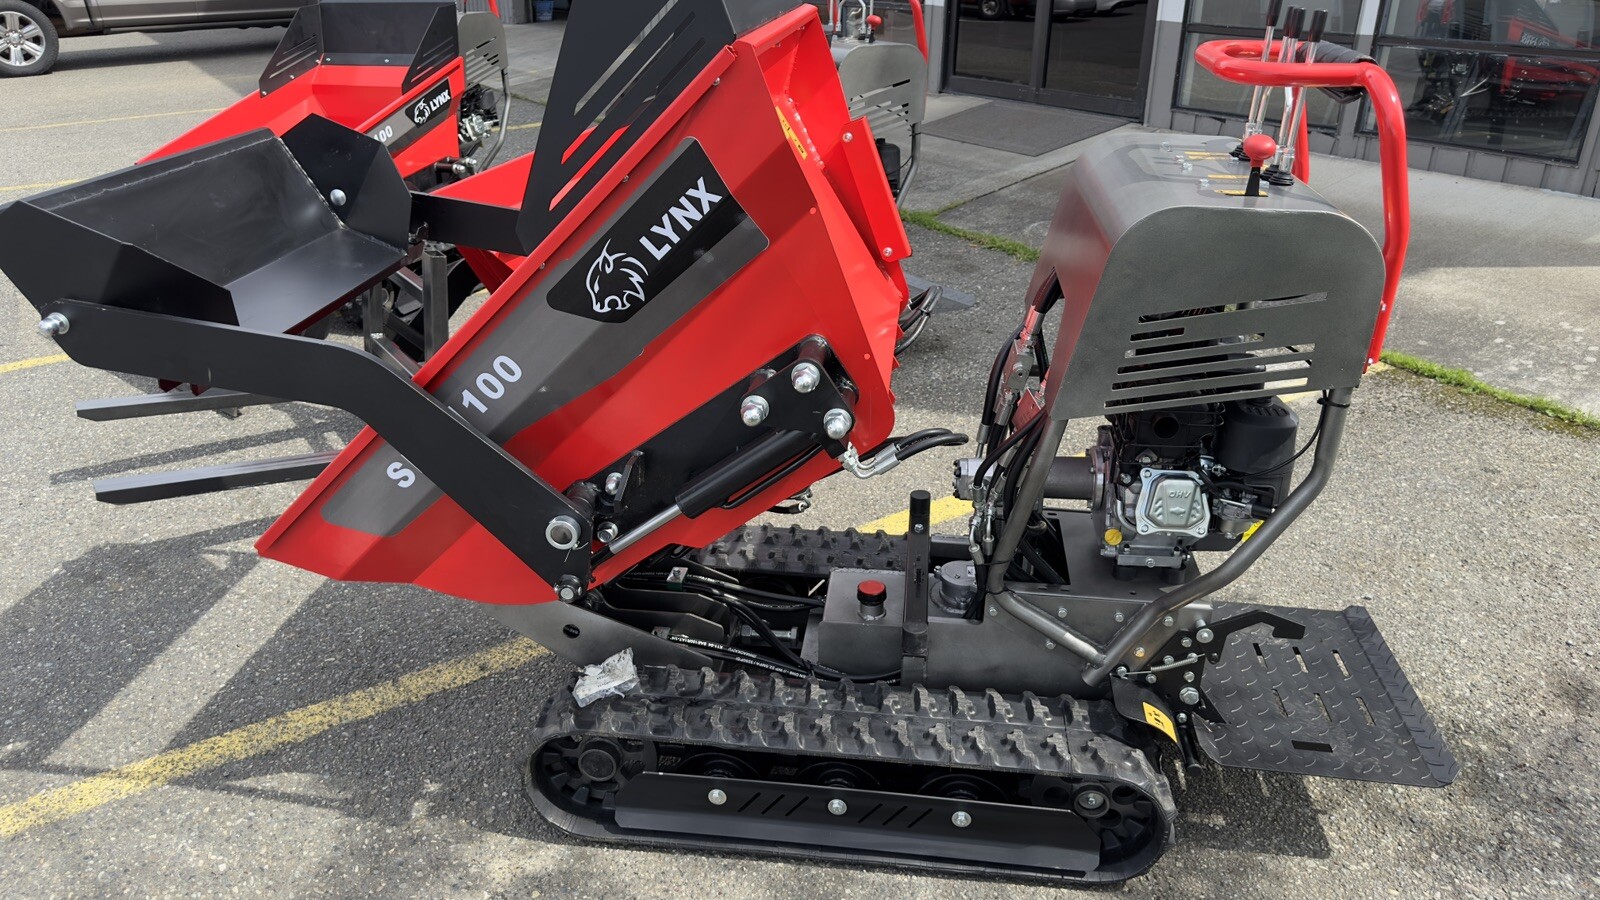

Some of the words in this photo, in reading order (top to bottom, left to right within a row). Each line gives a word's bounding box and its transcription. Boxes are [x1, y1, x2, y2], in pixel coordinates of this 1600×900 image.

[429, 89, 451, 112] LYNX
[639, 176, 723, 261] LYNX
[461, 355, 522, 414] 100
[1168, 490, 1191, 499] OHV
